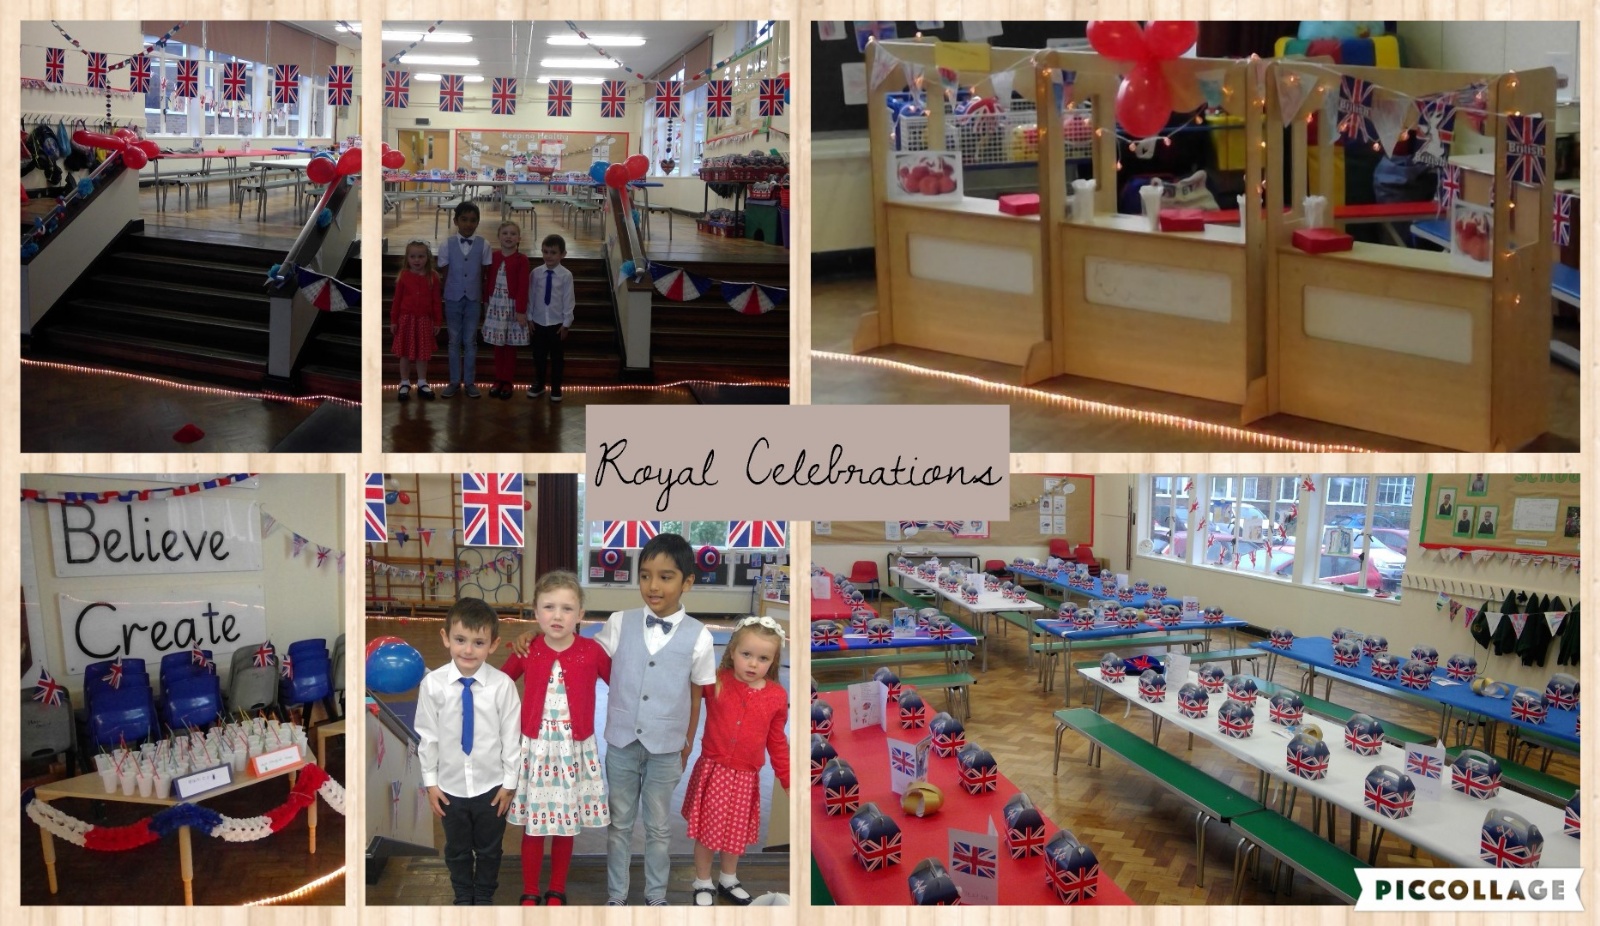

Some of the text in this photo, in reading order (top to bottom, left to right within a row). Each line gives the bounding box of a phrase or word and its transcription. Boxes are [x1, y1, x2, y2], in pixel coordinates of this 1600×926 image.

[1340, 99, 1369, 115] British
[502, 131, 569, 142] Keeping Healthy
[1508, 141, 1544, 157] British
[61, 502, 230, 564] Believe
[75, 602, 240, 659] Create
